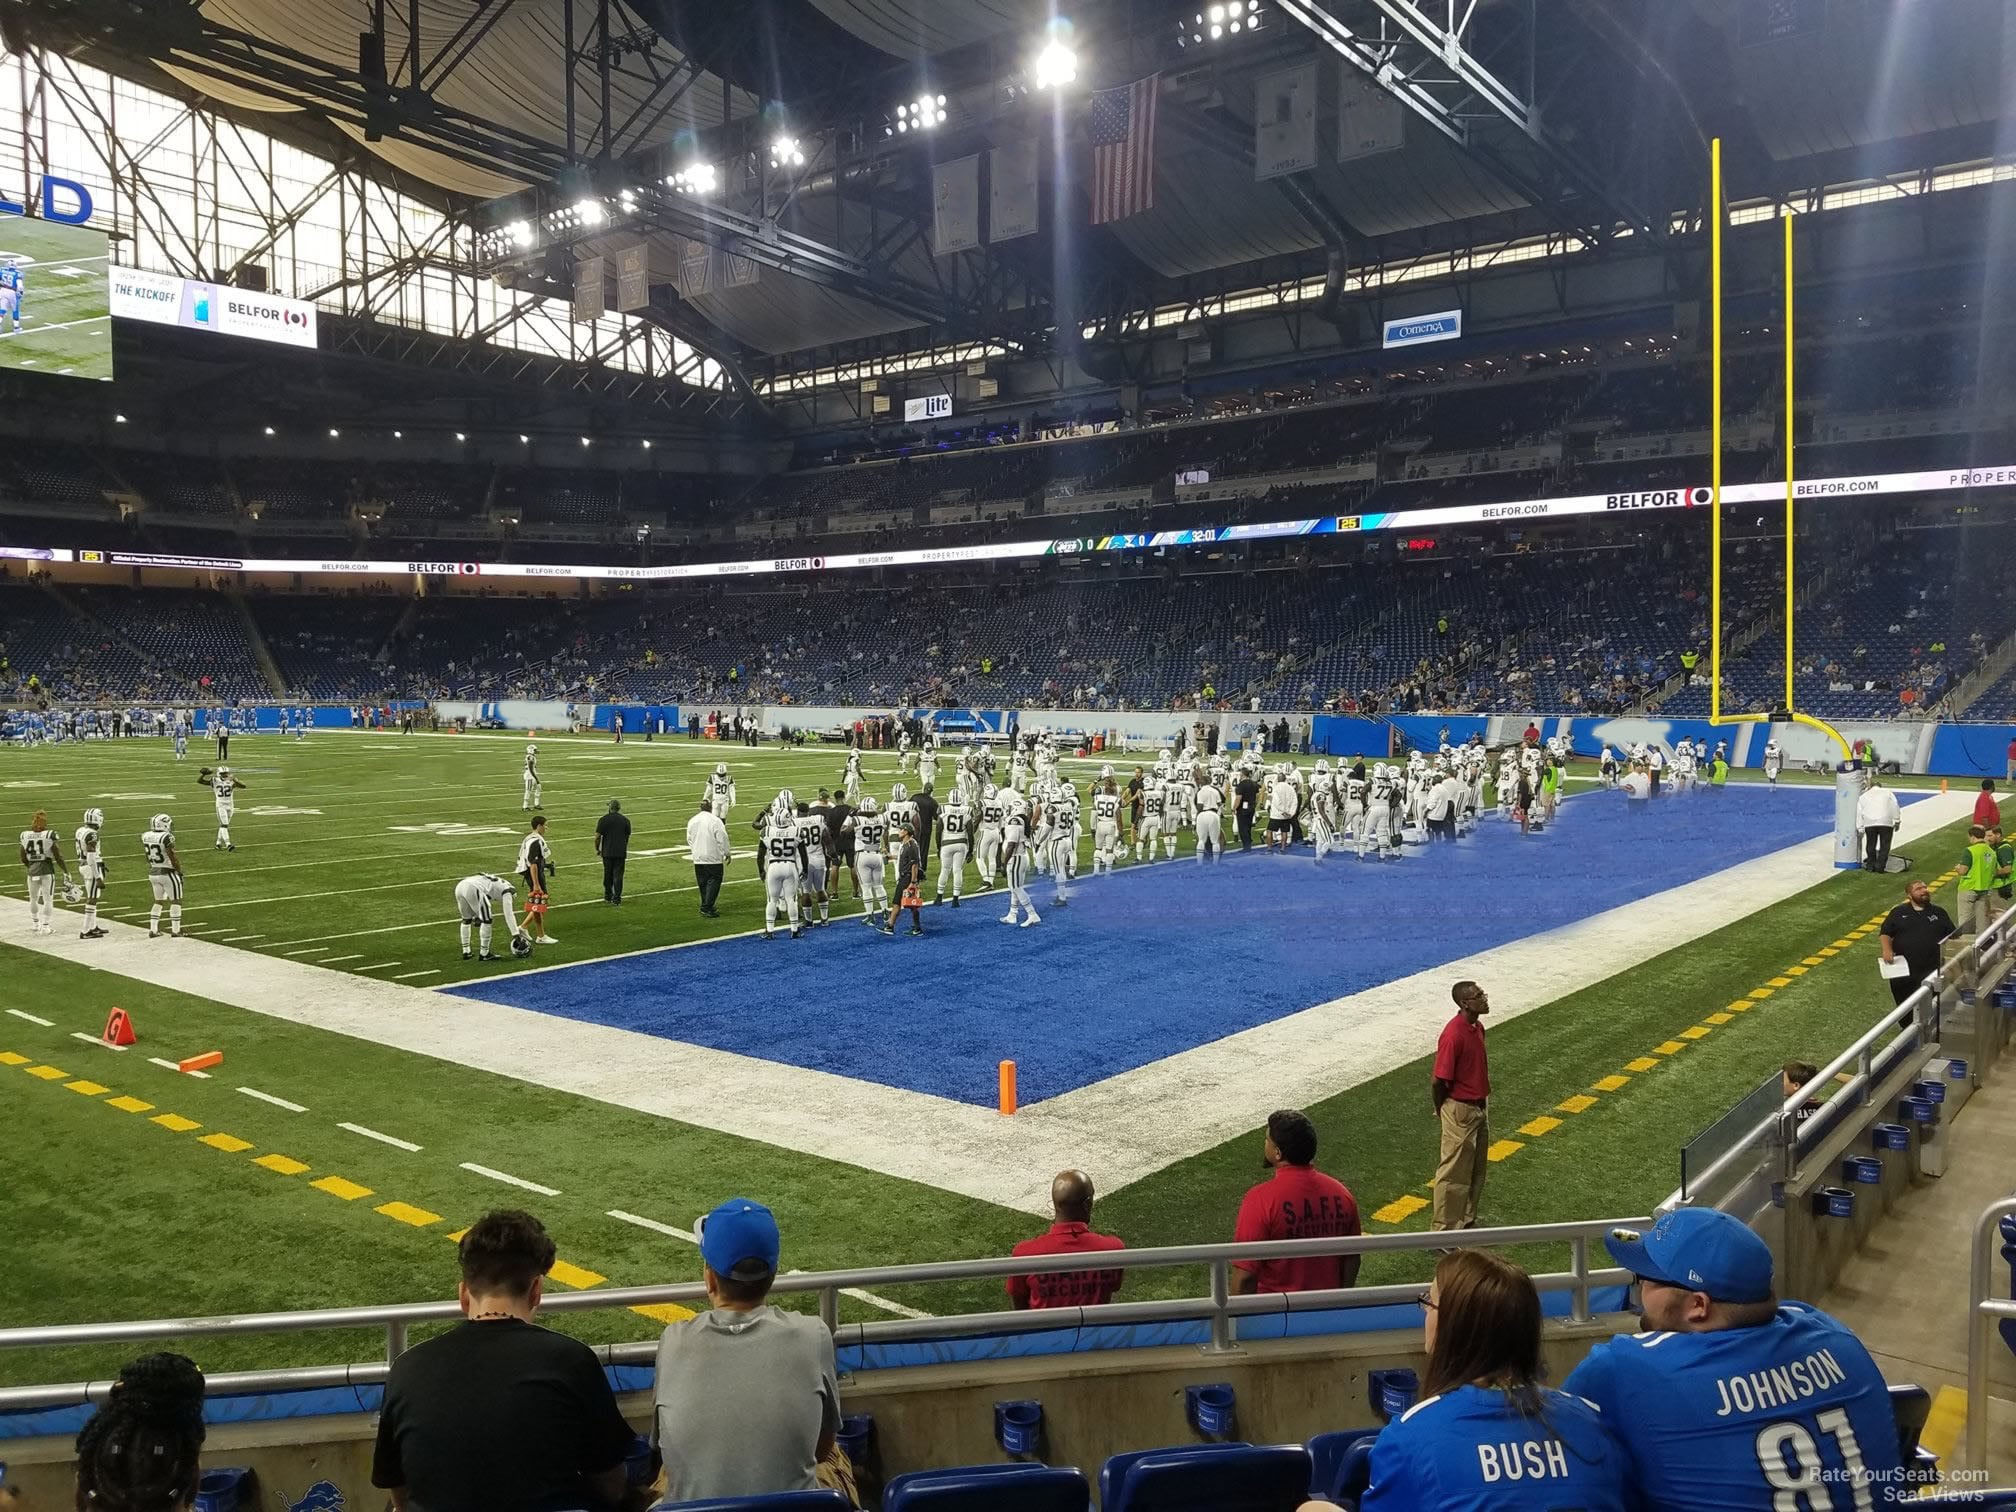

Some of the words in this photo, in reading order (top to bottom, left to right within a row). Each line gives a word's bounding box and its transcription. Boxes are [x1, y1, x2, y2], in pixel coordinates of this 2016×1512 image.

[115, 283, 132, 295] THE
[135, 287, 175, 303] KICKOFF
[228, 302, 280, 321] BELFOR
[925, 397, 948, 417] Lite
[1797, 480, 1879, 495] BELFOR.COM
[1606, 491, 1679, 509] BELFOR
[1482, 504, 1548, 517] BELFOR.COM
[1341, 518, 1356, 529] 25
[1139, 534, 1145, 546] 0
[1191, 530, 1216, 541] 32:01
[1087, 539, 1094, 550] 0
[408, 563, 454, 573] BELFOR
[774, 559, 807, 570] BELFOR
[858, 556, 894, 564] BELFOR.COM
[1178, 769, 1190, 781] 87
[216, 785, 232, 797] 32
[715, 784, 727, 794] 20
[1375, 785, 1393, 800] 77
[1170, 791, 1180, 805] 11
[1098, 801, 1115, 817] 58
[890, 811, 911, 828] 94
[946, 814, 965, 832] 61
[800, 826, 820, 847] 98
[862, 825, 883, 845] 92
[26, 840, 45, 856] 41
[770, 838, 795, 857] 65
[107, 1012, 122, 1041] G
[1715, 1348, 1847, 1418] JOHNSON
[1477, 1439, 1569, 1483] BUSH
[1756, 1407, 1874, 1512] 81
